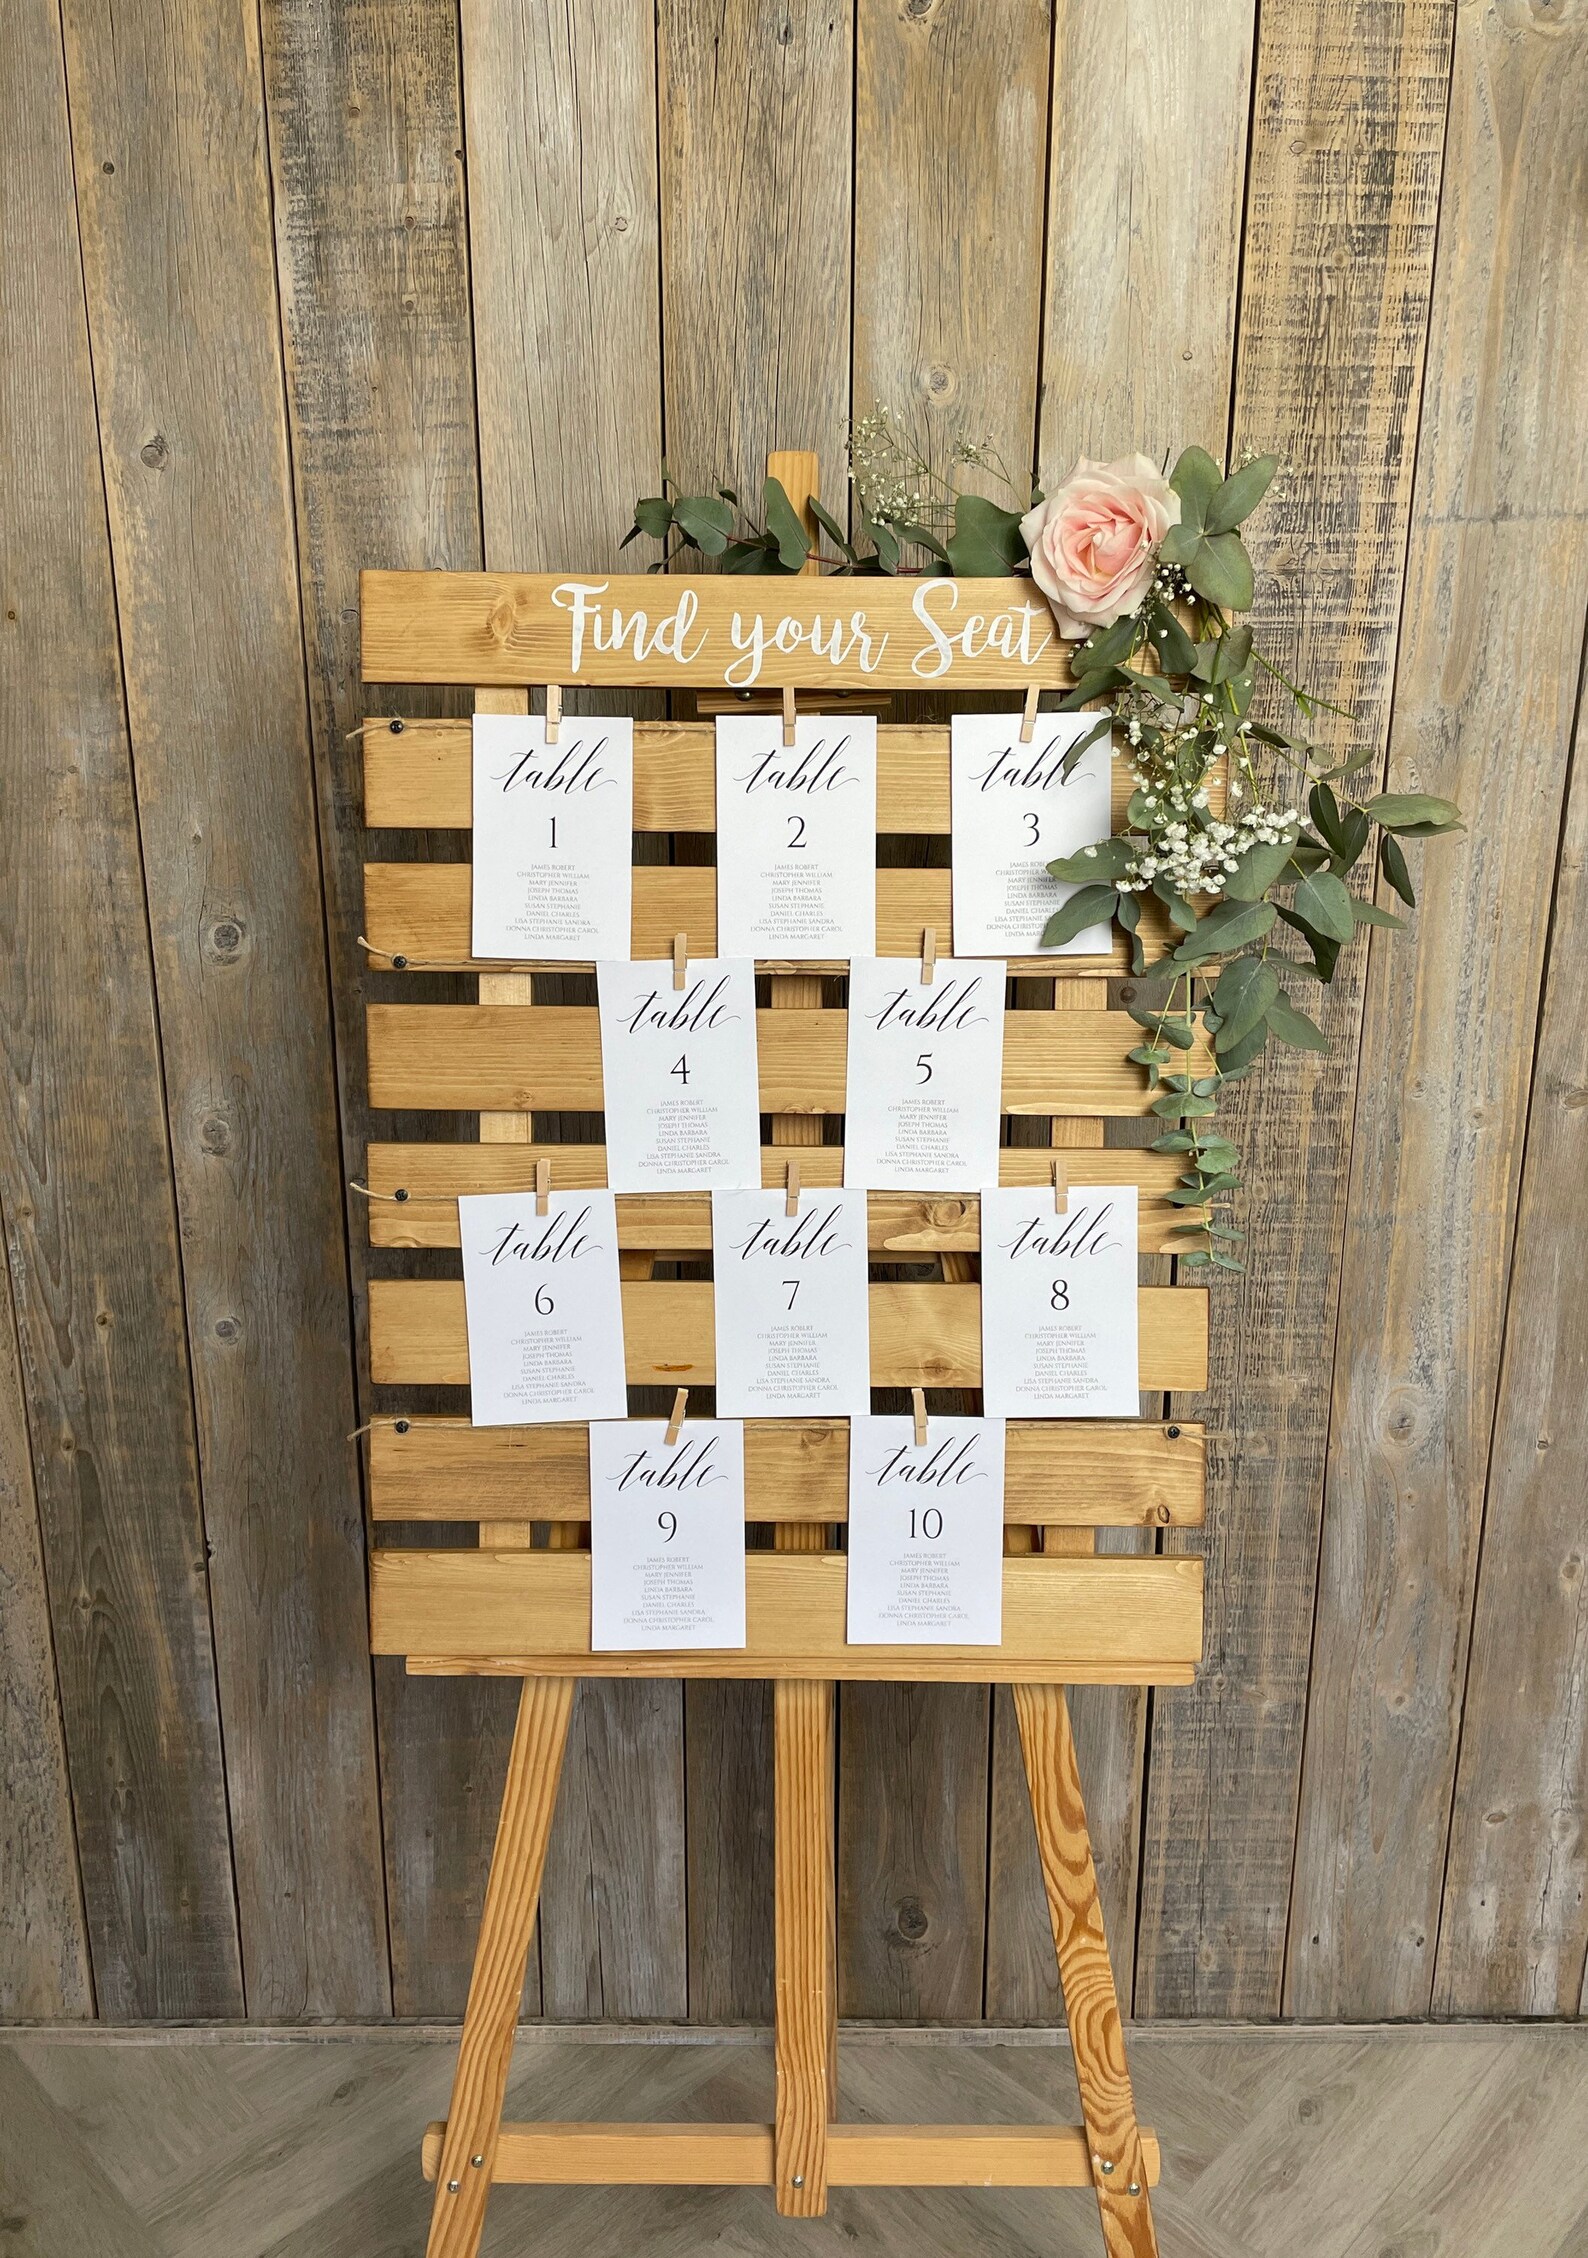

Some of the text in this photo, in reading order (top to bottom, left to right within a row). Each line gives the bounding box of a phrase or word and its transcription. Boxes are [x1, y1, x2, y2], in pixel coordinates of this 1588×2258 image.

[551, 579, 1053, 687] Find your Seat
[490, 737, 617, 795] table
[733, 735, 860, 794] table
[549, 816, 558, 848] 1
[787, 816, 807, 848] 2
[1023, 813, 1040, 847] 3
[1010, 861, 1028, 869] JAMES
[616, 976, 741, 1034] table
[865, 975, 989, 1032] table
[670, 1054, 691, 1084] 4
[916, 1052, 933, 1085] 5
[479, 1206, 603, 1266] table
[729, 1204, 852, 1260] table
[998, 1201, 1122, 1259] table
[535, 1283, 554, 1315] 6
[782, 1281, 800, 1310] 7
[1051, 1279, 1069, 1310] 8
[510, 1337, 554, 1345] CHRISTOPHER
[524, 1328, 568, 1338] JAMES ROBERT
[606, 1436, 728, 1491] table
[865, 1433, 988, 1487] table
[658, 1512, 677, 1543] 9
[909, 1508, 943, 1539] 10
